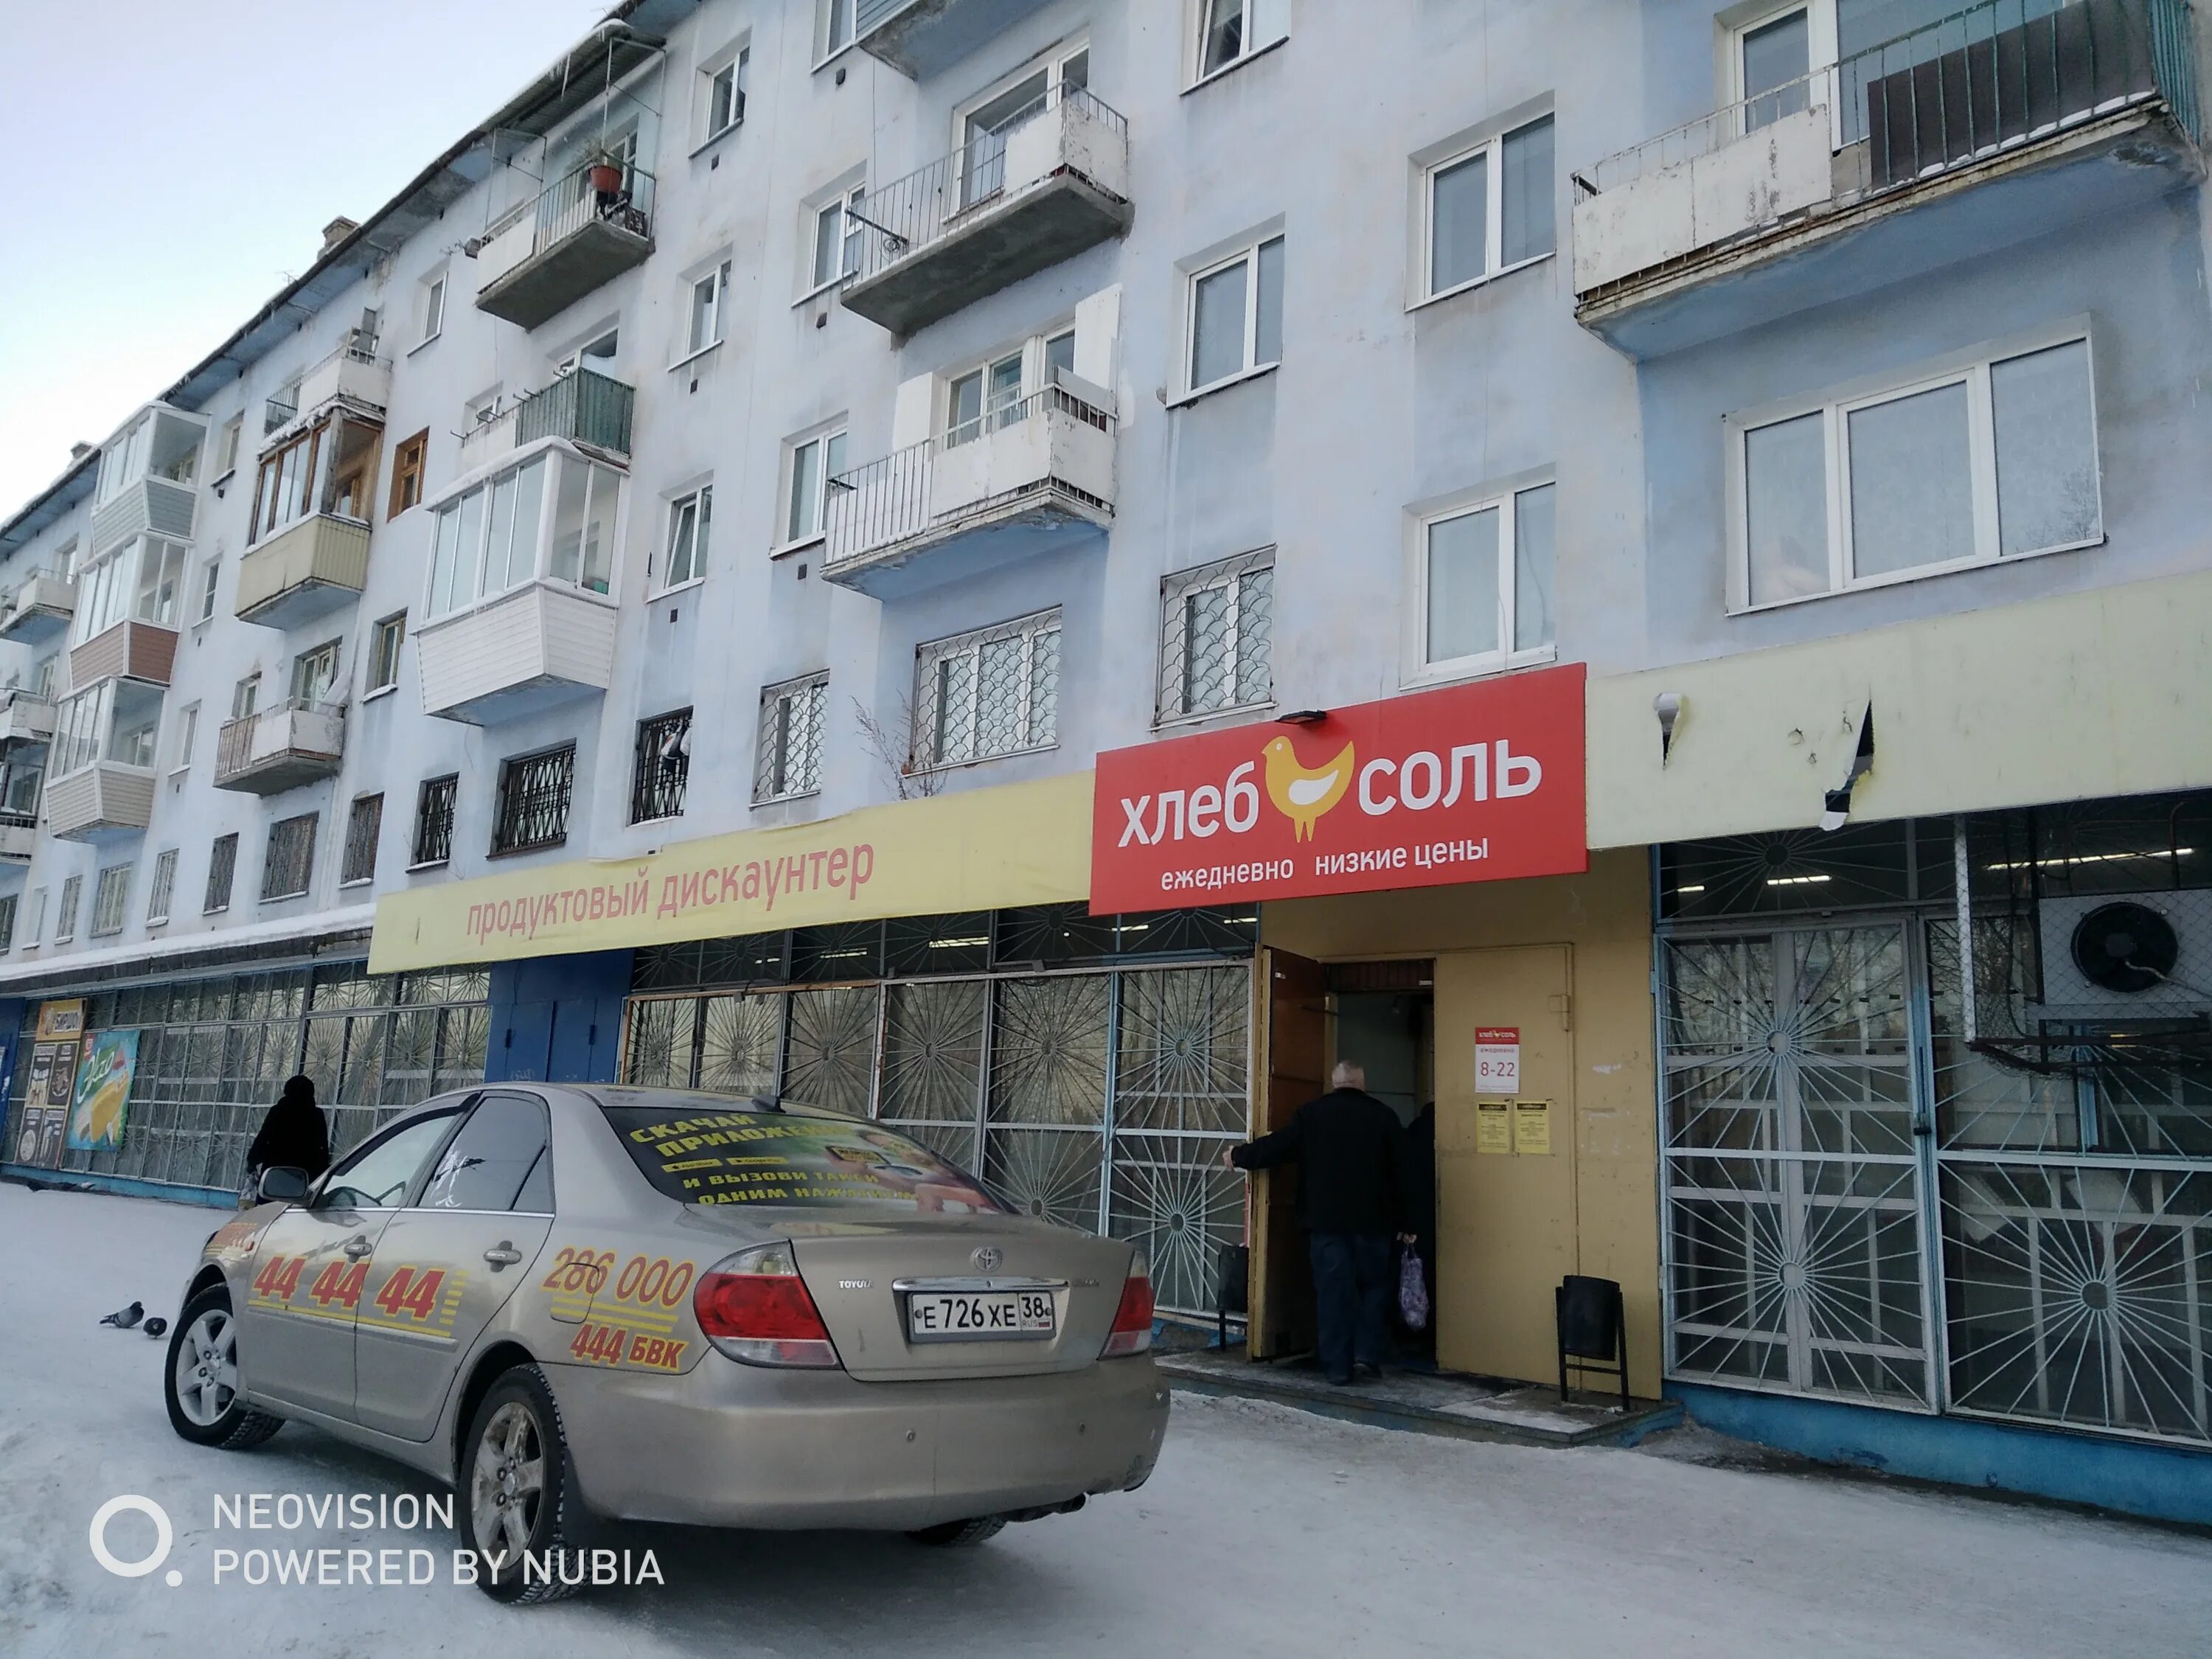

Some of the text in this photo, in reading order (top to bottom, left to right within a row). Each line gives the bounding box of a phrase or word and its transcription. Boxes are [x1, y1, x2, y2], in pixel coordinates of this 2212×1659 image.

[1118, 739, 1543, 848] хлеб соль
[1161, 838, 1489, 891] ежедневно низкие цены
[467, 843, 874, 945] продуктовый дискаунтер
[1481, 1062, 1514, 1077] 8-22
[630, 1113, 757, 1142] СКАЧАЙ
[698, 1188, 787, 1205] ОДНИМ
[709, 1172, 807, 1185] ВЫЗОВИ
[254, 1256, 445, 1321] 44 44 44
[542, 1247, 695, 1308] 286 000
[1021, 1297, 1043, 1318] 38
[568, 1324, 688, 1370] 444 БВК
